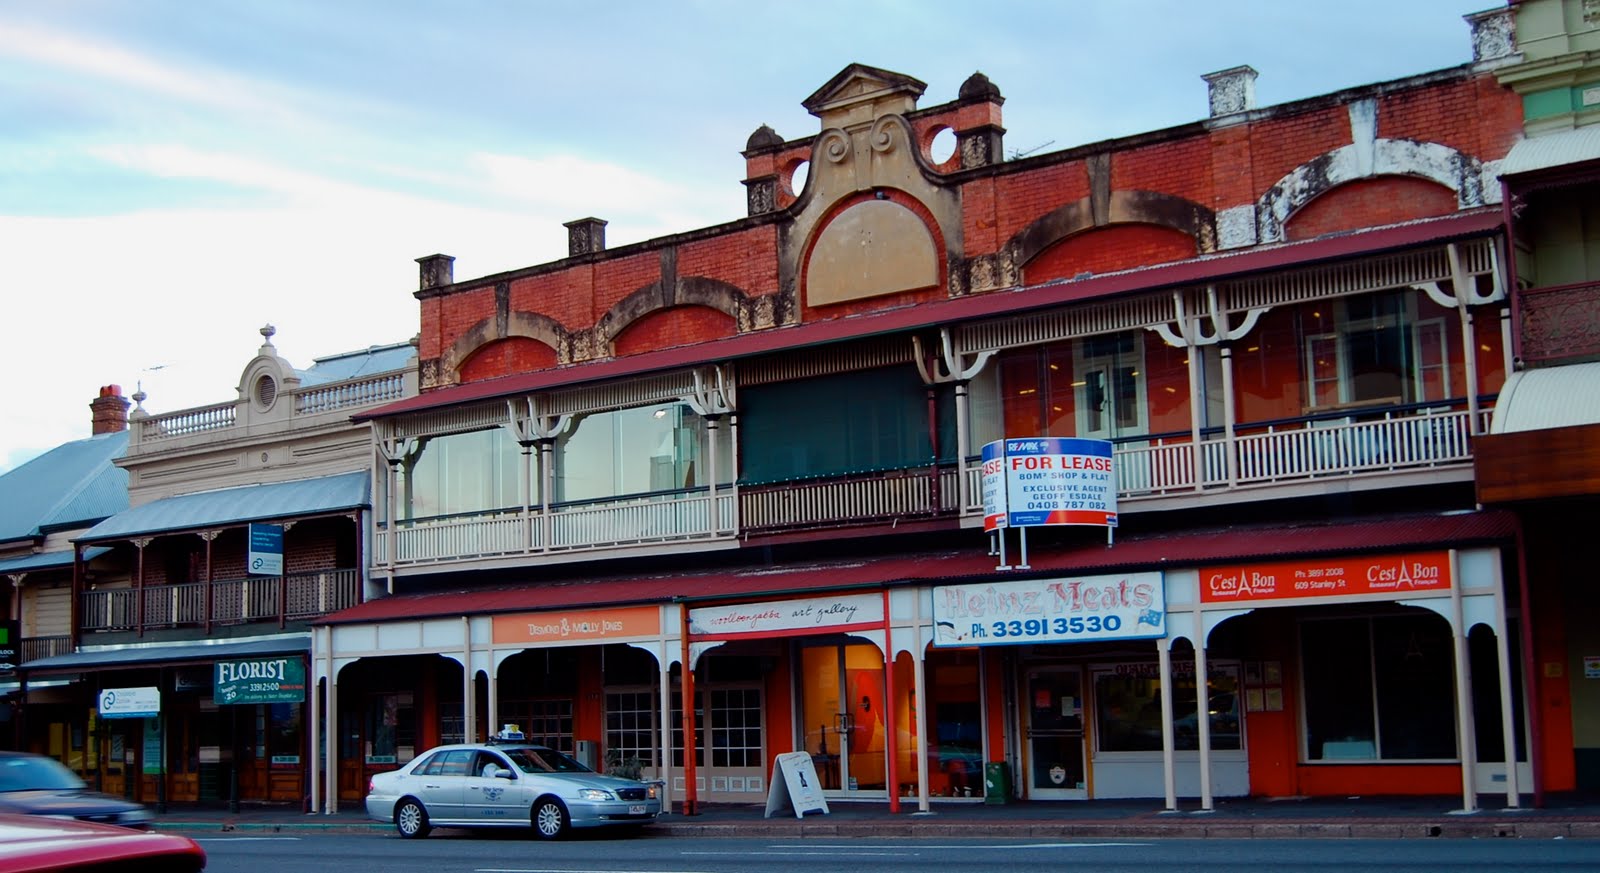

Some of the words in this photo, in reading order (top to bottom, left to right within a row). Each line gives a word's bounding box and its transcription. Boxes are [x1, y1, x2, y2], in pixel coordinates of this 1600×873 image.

[1012, 457, 1053, 470] FOR
[1061, 457, 1112, 472] LEASE
[1090, 473, 1109, 481] FLAT
[1082, 485, 1107, 493] AGENT
[1027, 501, 1059, 510] 0408
[1088, 501, 1106, 510] 082
[1210, 574, 1237, 590] C'est
[1252, 572, 1275, 587] Bon
[1367, 565, 1396, 581] C'est
[1413, 563, 1438, 578] Bon
[1295, 581, 1309, 590] 609
[1310, 579, 1336, 590] Stanley
[1338, 579, 1346, 587] St
[1046, 580, 1154, 612] Meats
[791, 605, 813, 617] art
[817, 602, 859, 623] gallery
[560, 617, 571, 636] &
[600, 620, 622, 635] JONES
[972, 623, 988, 638] Ph.
[992, 618, 1048, 637] 3391
[1053, 615, 1121, 634] 3530
[218, 659, 287, 684] FLORIST
